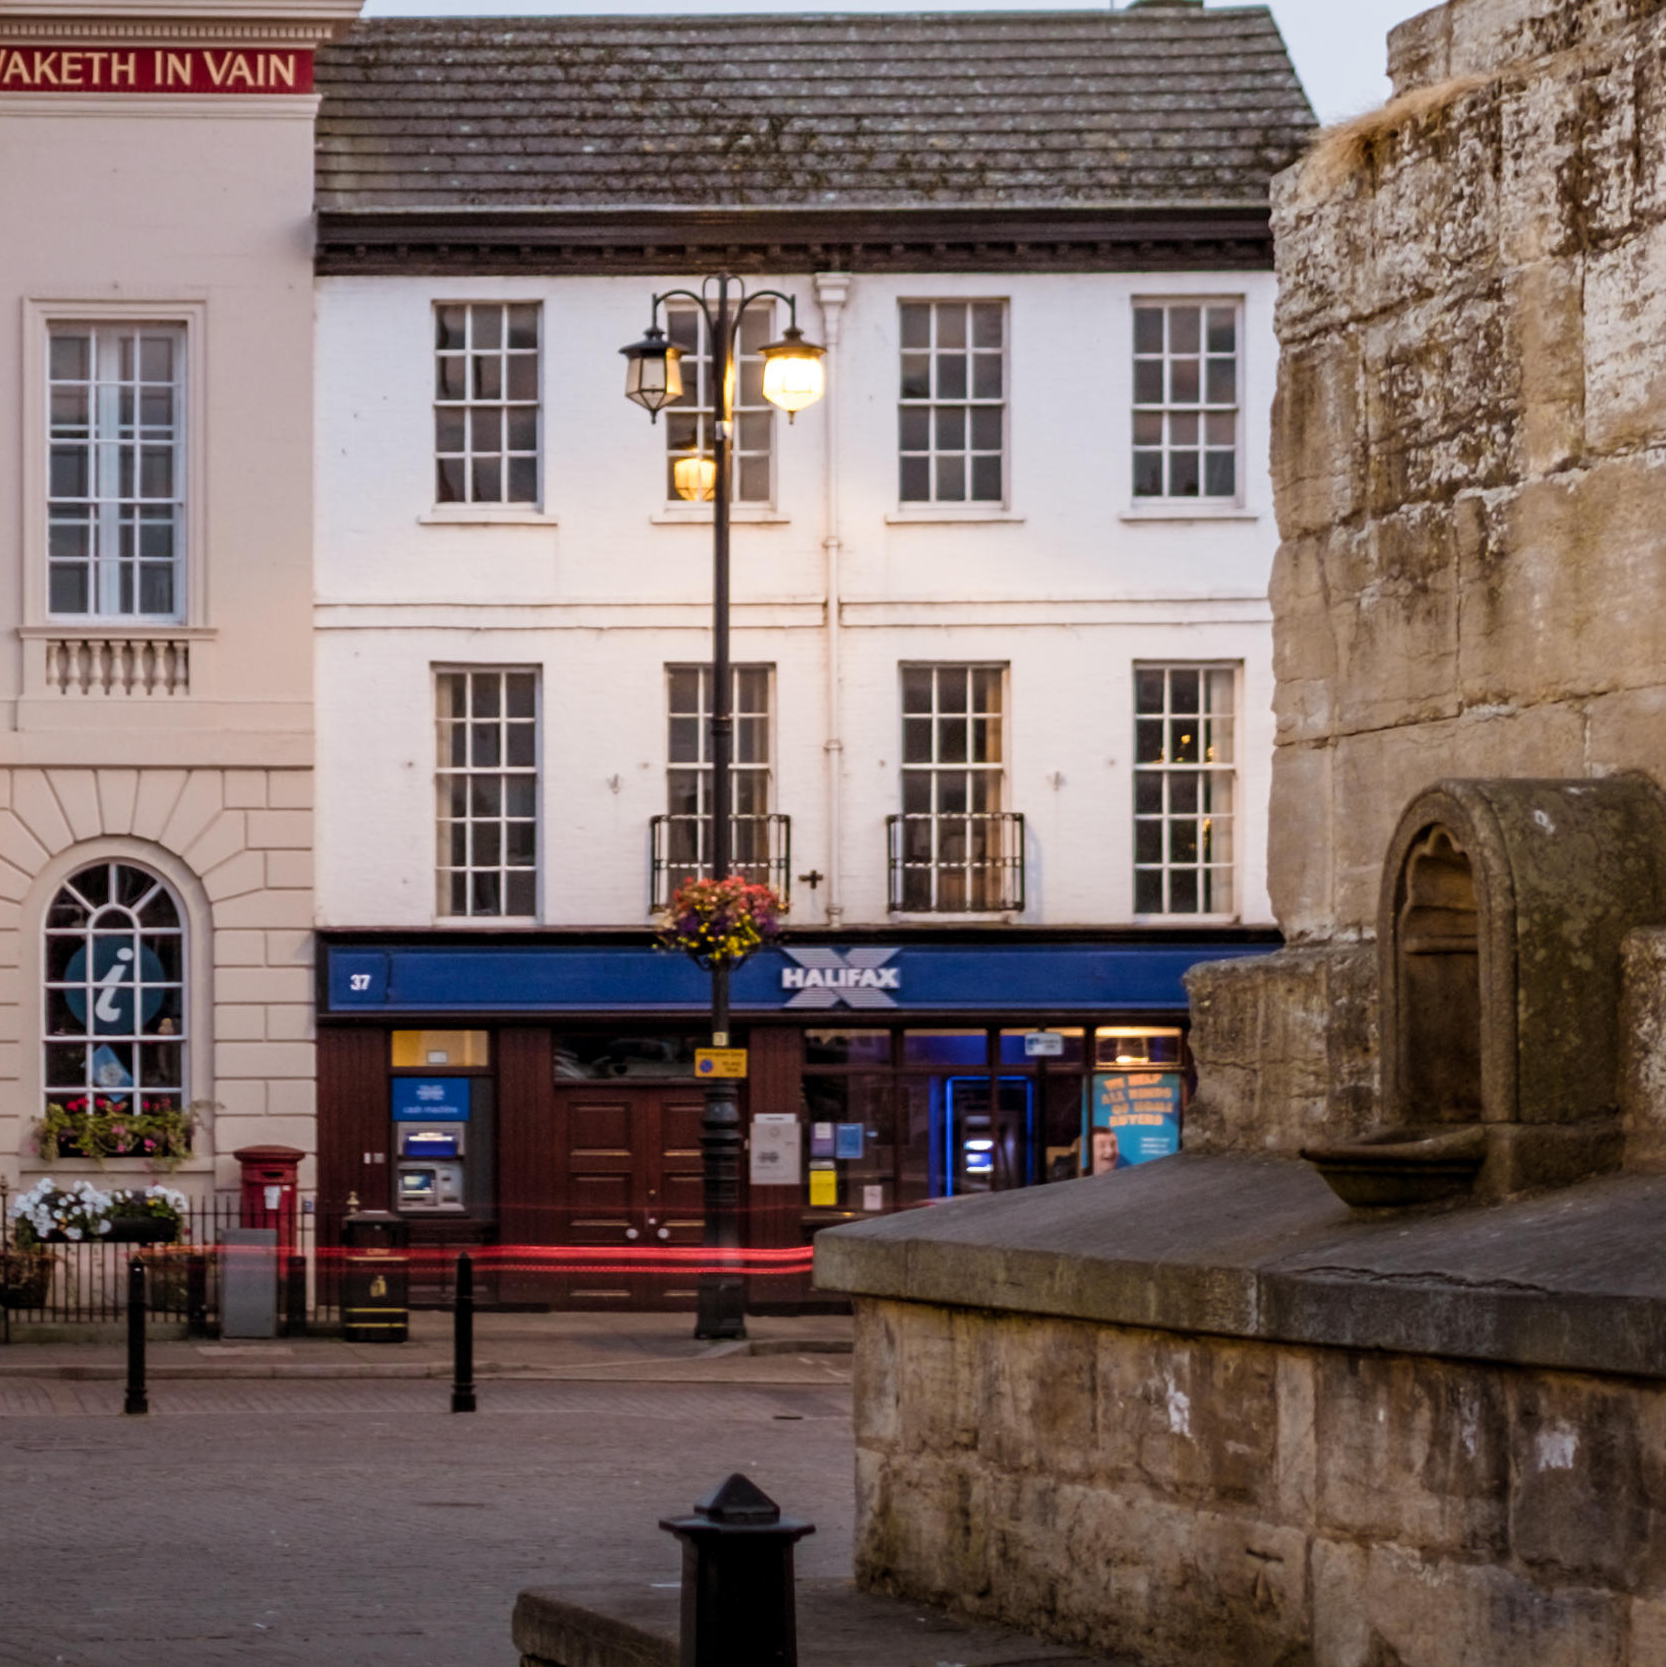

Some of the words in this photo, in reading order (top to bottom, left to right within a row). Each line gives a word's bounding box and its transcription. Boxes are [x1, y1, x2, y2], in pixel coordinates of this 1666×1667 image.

[154, 50, 192, 86] IN
[203, 51, 296, 87] VAIN
[349, 973, 371, 991] 37
[781, 967, 901, 989] HALIFAX
